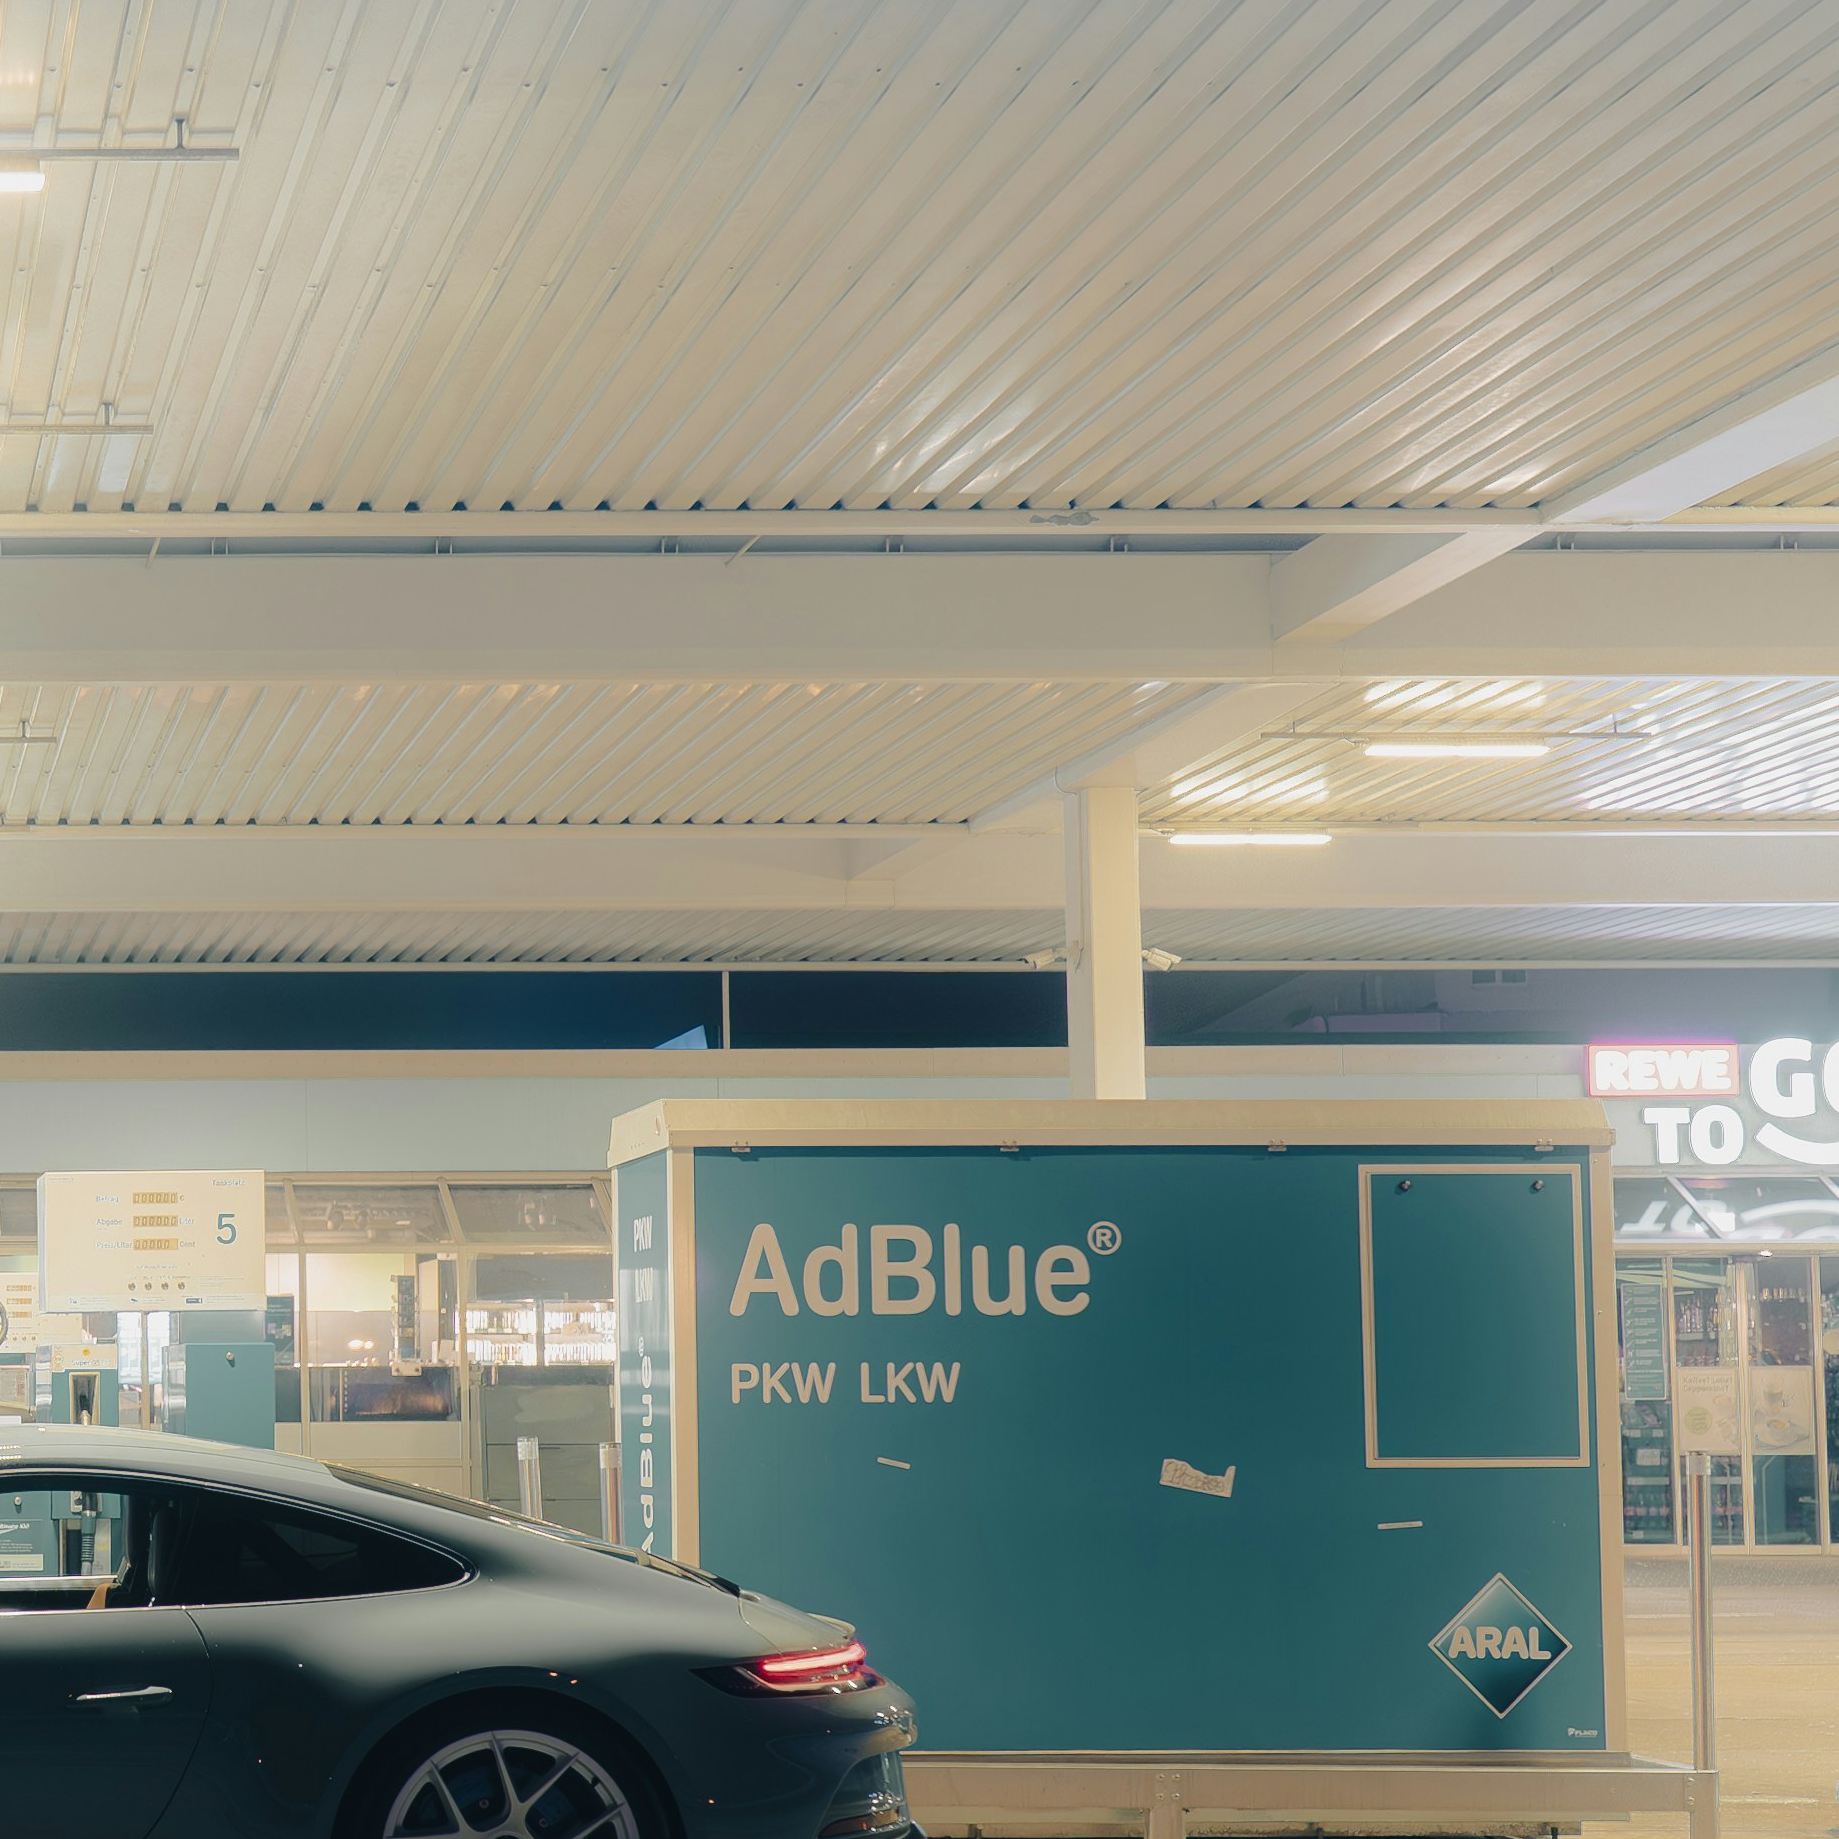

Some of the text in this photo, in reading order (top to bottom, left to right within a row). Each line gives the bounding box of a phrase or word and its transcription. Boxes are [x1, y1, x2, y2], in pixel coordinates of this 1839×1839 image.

[1595, 1050, 1731, 1091] REWE
[1750, 1037, 1839, 1118] G
[1644, 1105, 1743, 1164] TO
[216, 1213, 237, 1245] 5
[634, 1215, 653, 1253] PKW
[730, 1362, 961, 1405] PKW LKW
[1448, 1626, 1552, 1660] ARAL
